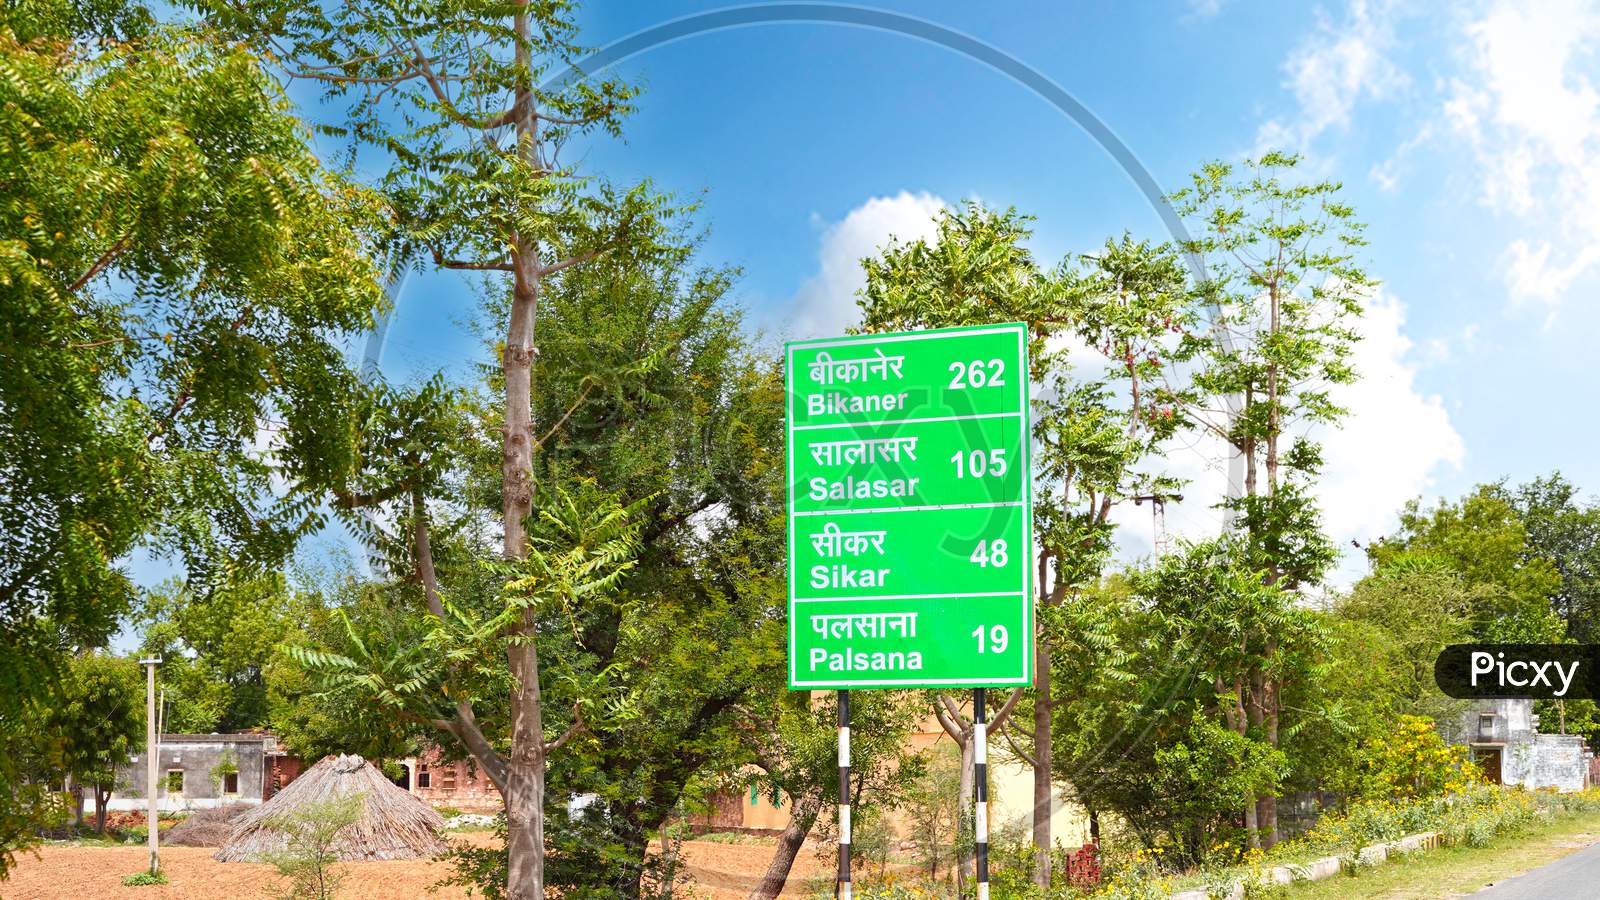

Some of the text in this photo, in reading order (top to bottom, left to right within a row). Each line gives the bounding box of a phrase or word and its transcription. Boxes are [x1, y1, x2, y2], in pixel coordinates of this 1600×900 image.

[808, 349, 904, 384] बीकानेर
[949, 359, 1005, 389] 262
[808, 393, 907, 415] Bikaner
[809, 437, 918, 465] सालासर
[950, 449, 1007, 478] 105
[809, 476, 919, 500] Salasar
[810, 522, 886, 557] सीकर
[970, 539, 1008, 567] 48
[810, 565, 890, 588] Sikar
[810, 612, 917, 639] पलसाना
[972, 625, 1008, 653] 19
[810, 648, 922, 671] Palsana
